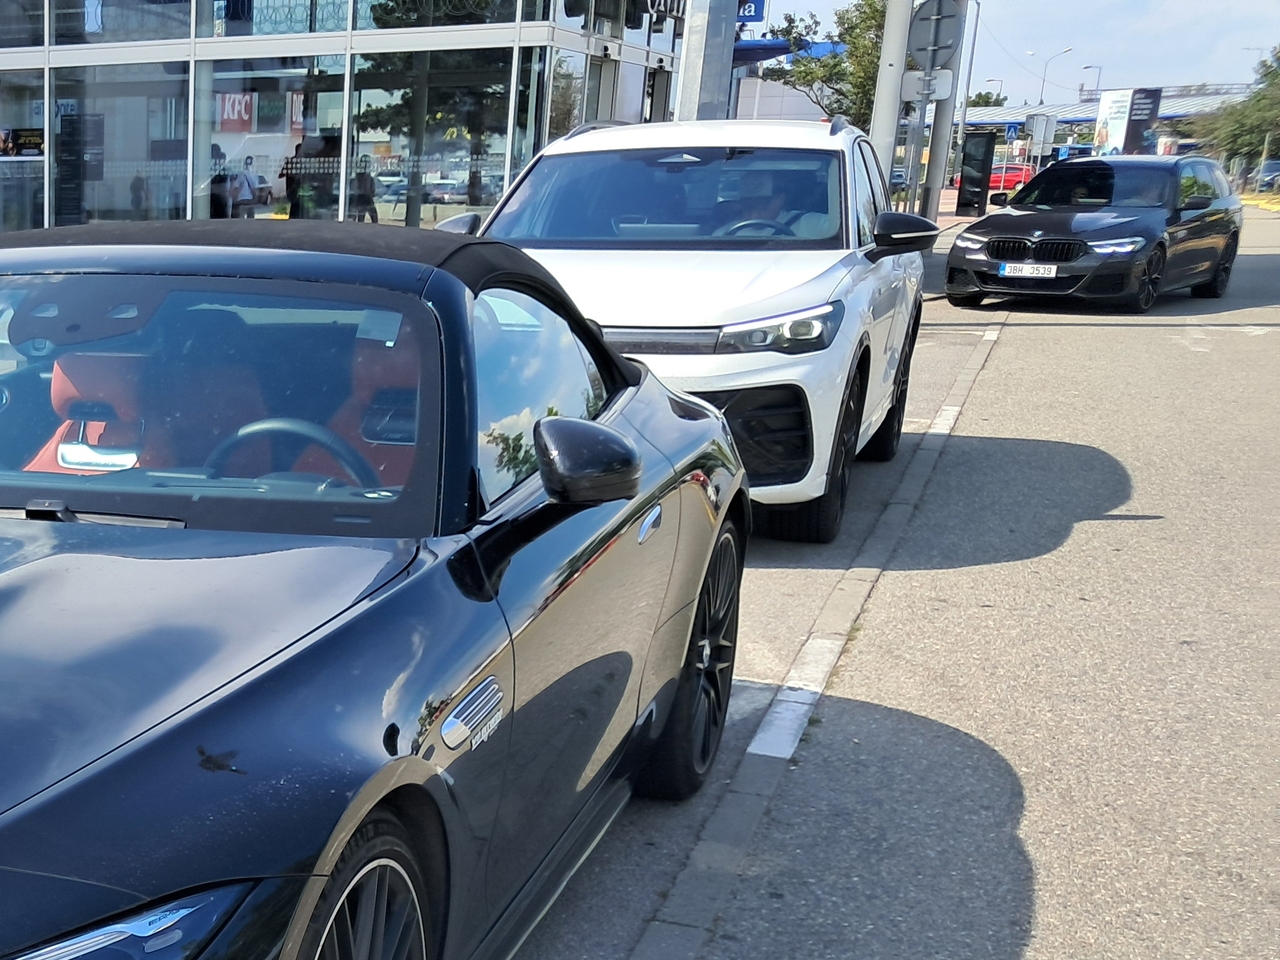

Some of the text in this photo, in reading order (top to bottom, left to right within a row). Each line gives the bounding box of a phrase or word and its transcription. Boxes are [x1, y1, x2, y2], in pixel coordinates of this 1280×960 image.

[223, 94, 250, 120] KFC
[1007, 265, 1024, 275] 3BH
[1029, 266, 1052, 276] 3539
